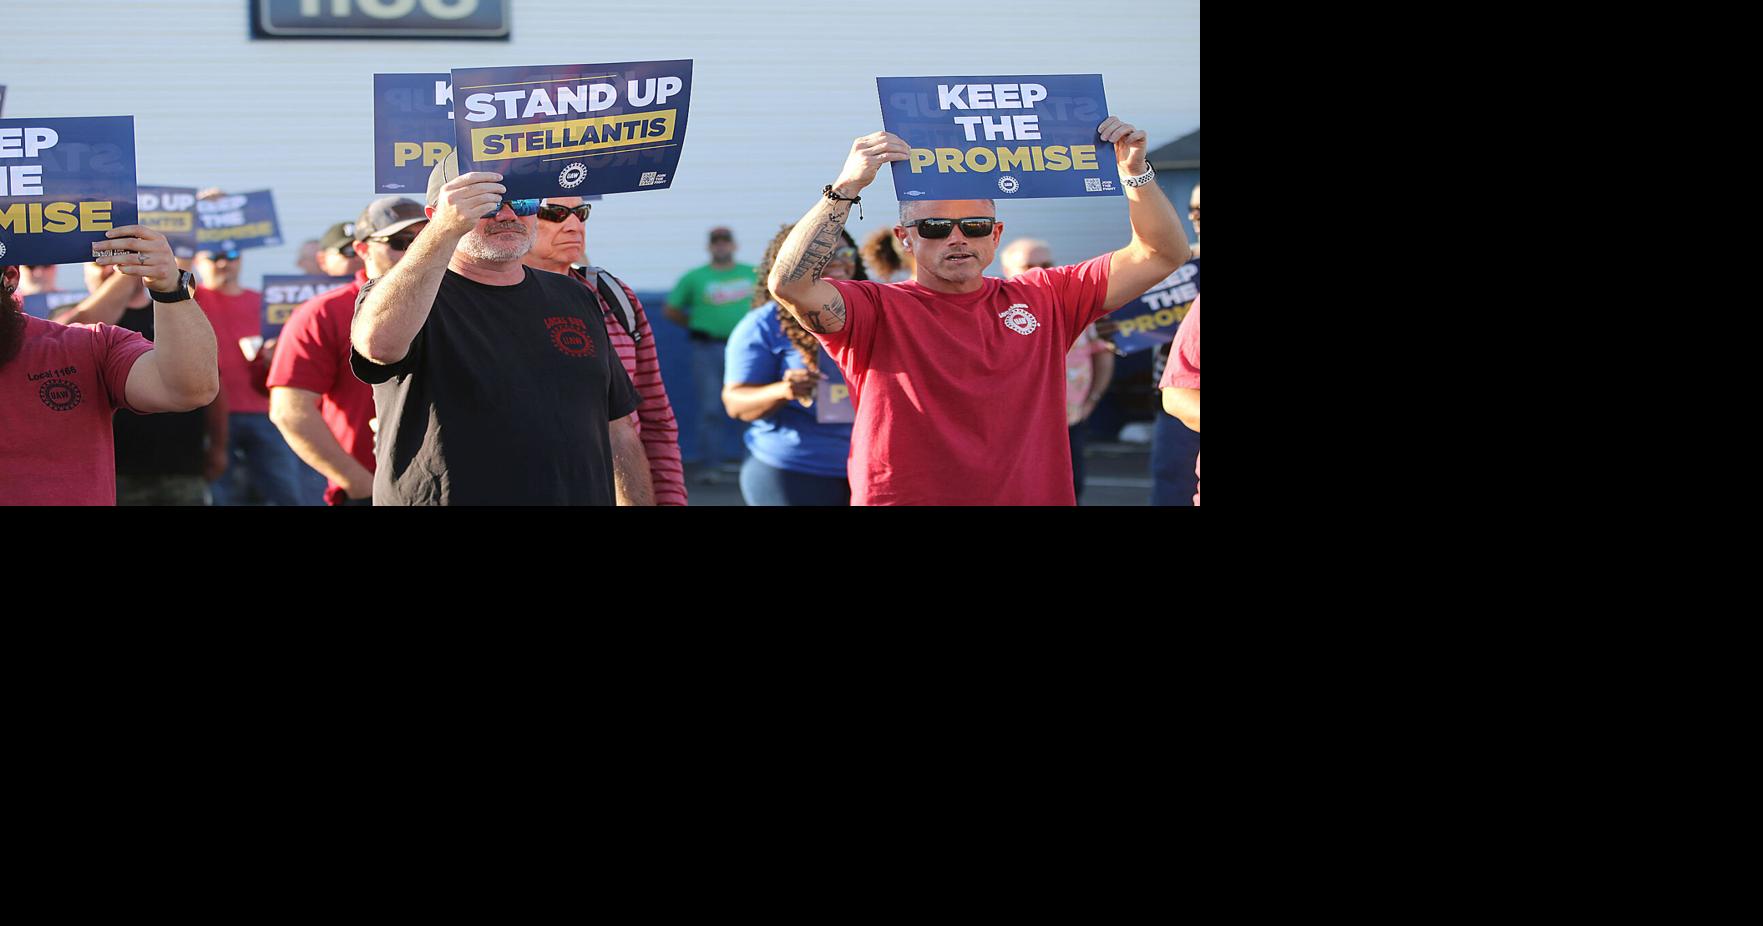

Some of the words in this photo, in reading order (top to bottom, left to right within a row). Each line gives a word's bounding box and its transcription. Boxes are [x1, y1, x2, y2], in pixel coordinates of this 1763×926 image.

[464, 85, 618, 122] STAND
[627, 76, 683, 107] UP
[937, 84, 1048, 110] KEEP
[0, 127, 58, 158] EP
[482, 118, 666, 155] STELLANTIS
[954, 115, 1041, 142] THE
[909, 144, 1099, 174] PROMISE
[0, 201, 113, 234] MISE
[27, 369, 53, 381] Local
